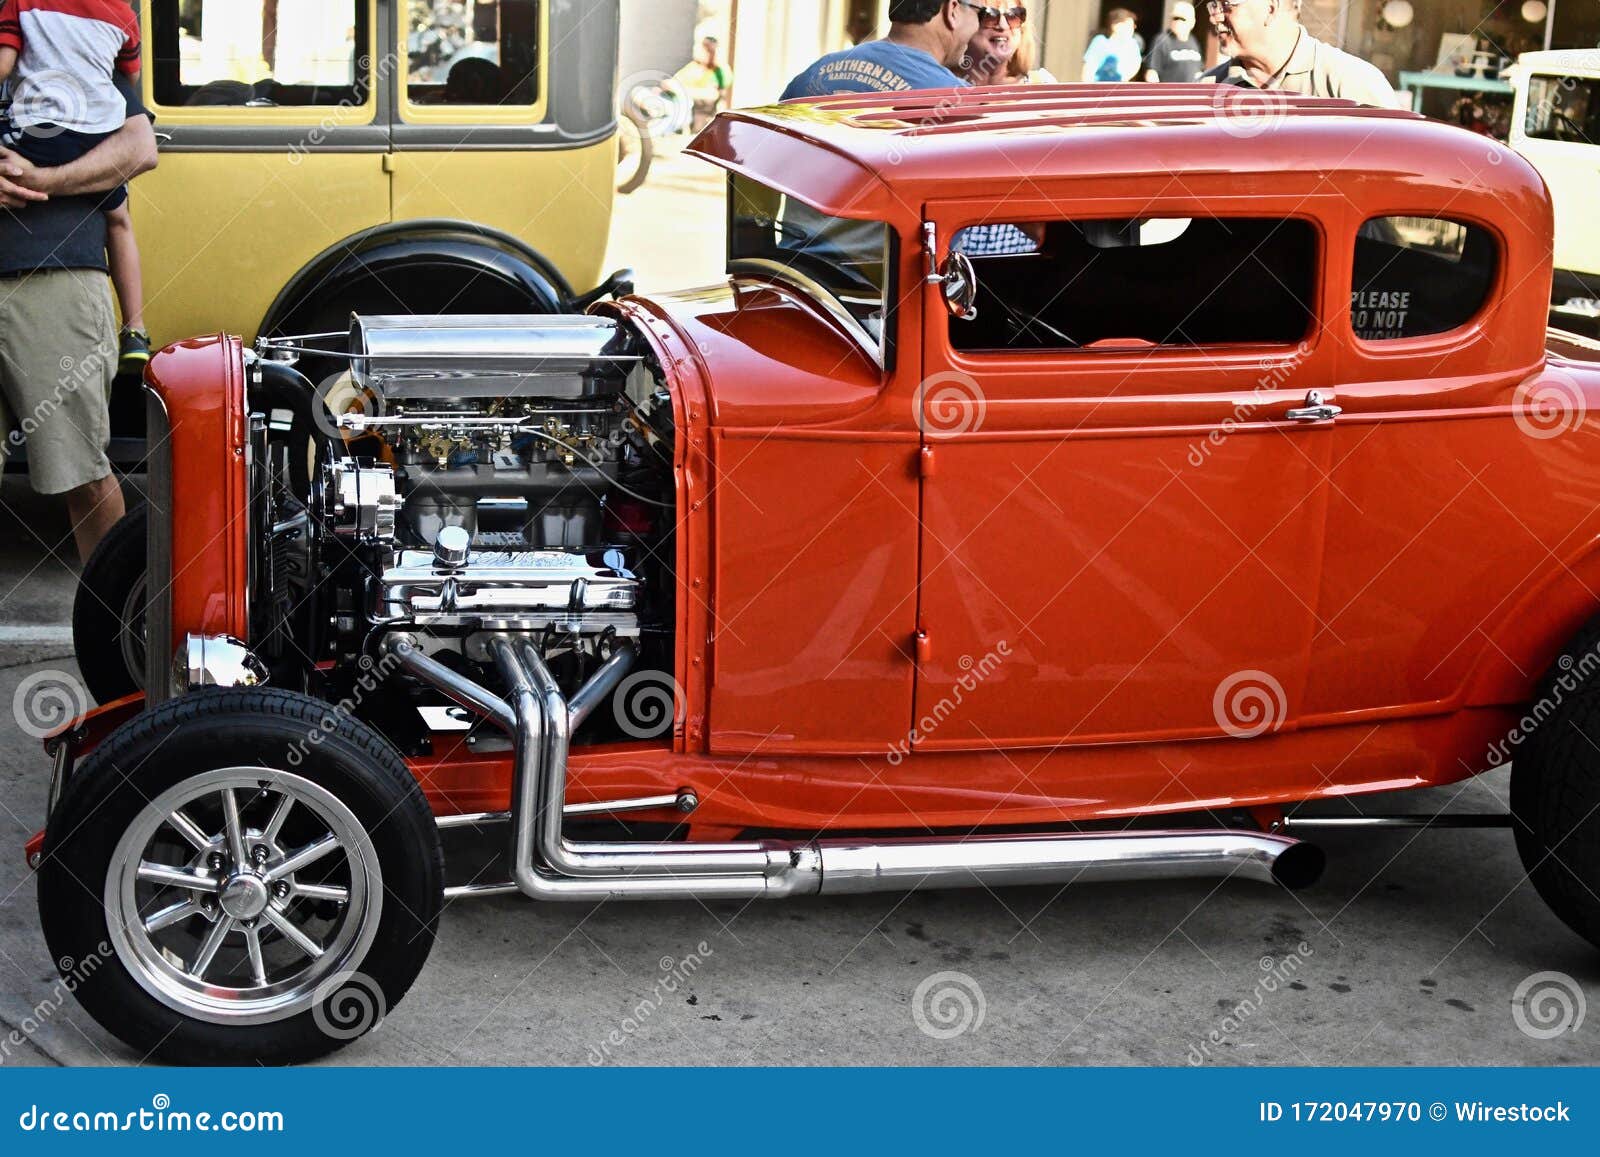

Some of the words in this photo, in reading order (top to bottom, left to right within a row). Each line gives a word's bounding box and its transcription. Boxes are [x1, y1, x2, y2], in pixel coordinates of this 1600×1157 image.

[818, 59, 884, 78] SOUTHERN
[1351, 291, 1410, 309] PLEASE
[1372, 311, 1408, 329] NOT
